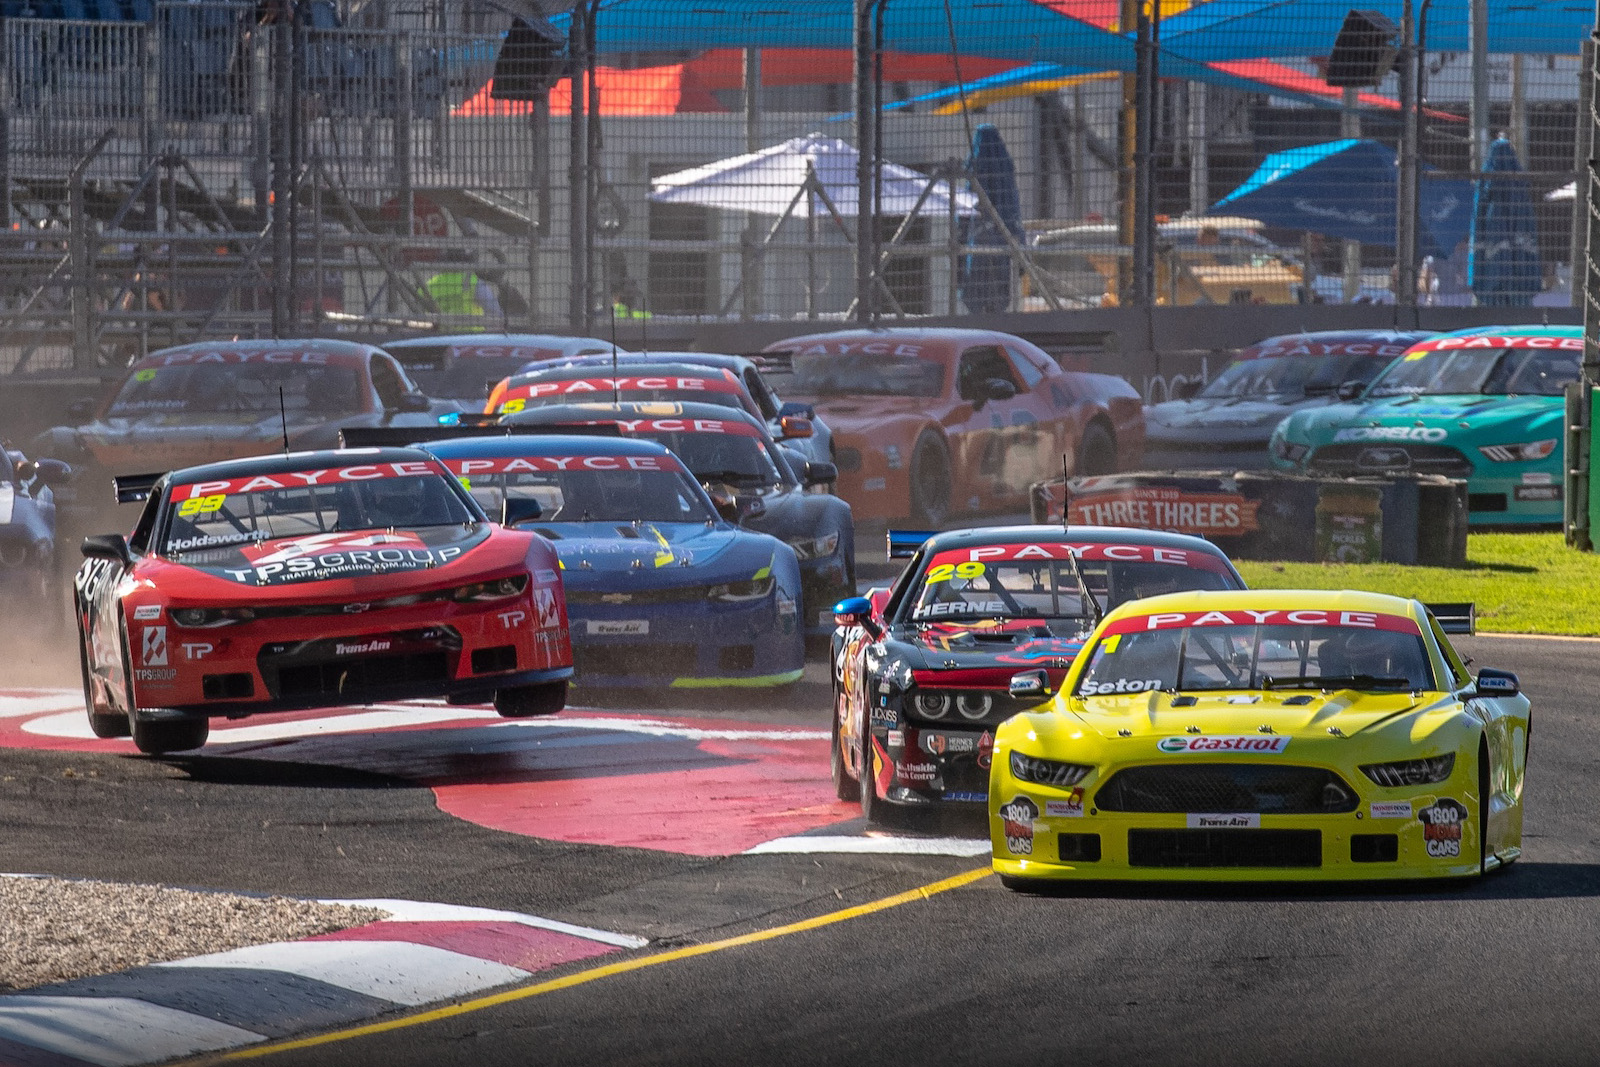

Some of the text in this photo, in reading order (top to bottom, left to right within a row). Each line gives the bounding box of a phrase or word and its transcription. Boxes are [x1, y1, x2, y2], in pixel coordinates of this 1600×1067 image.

[1437, 336, 1584, 349] PAYCE
[164, 351, 328, 365] PAYCE
[530, 377, 705, 397] PAYCE
[461, 456, 661, 473] PAYCE
[189, 463, 434, 498] PAYCE
[178, 494, 227, 517] 99
[1079, 500, 1241, 528] THREE THREES
[166, 529, 270, 551] Holdsworth
[969, 545, 1190, 565] PAYCE
[224, 547, 462, 583] TPSGROUP
[925, 562, 986, 585] 29
[911, 601, 1005, 619] HERNE
[498, 611, 525, 629] TP
[1147, 610, 1378, 629] PAYCE
[181, 643, 213, 659] TP
[369, 640, 390, 651] Am
[1101, 635, 1122, 654] 1
[135, 669, 177, 680] TPSGROUP
[1079, 678, 1162, 696] Seton
[1188, 737, 1281, 751] Castrol
[1007, 805, 1031, 822] 1800
[1427, 807, 1459, 824] 1800
[1008, 836, 1032, 854] CARS
[1427, 840, 1459, 856] CARS
